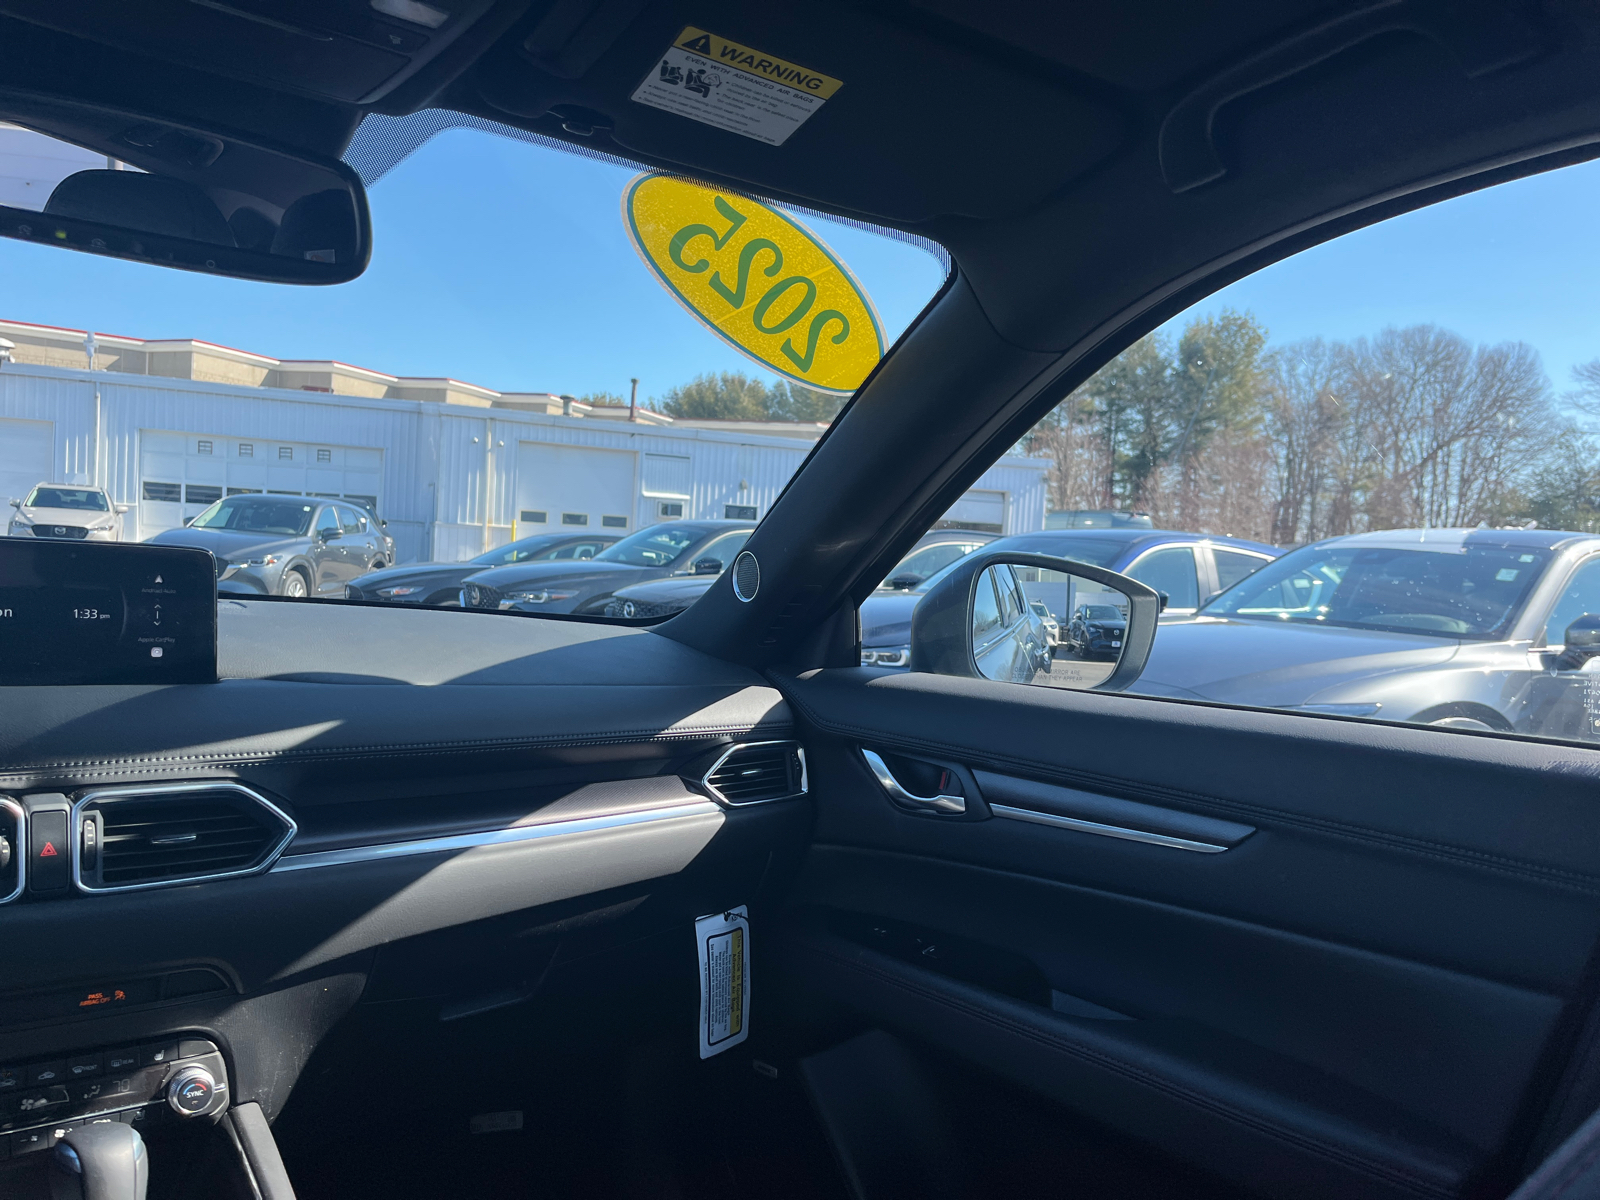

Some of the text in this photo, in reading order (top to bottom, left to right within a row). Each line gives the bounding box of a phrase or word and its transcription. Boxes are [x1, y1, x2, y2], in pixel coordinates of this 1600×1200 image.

[719, 45, 825, 90] WARNING
[684, 55, 814, 103] EVEN WITH ADVANCED AIR BAGS
[73, 608, 98, 620] 1:33
[112, 1079, 130, 1093] 70
[186, 1089, 204, 1098] SYNC
